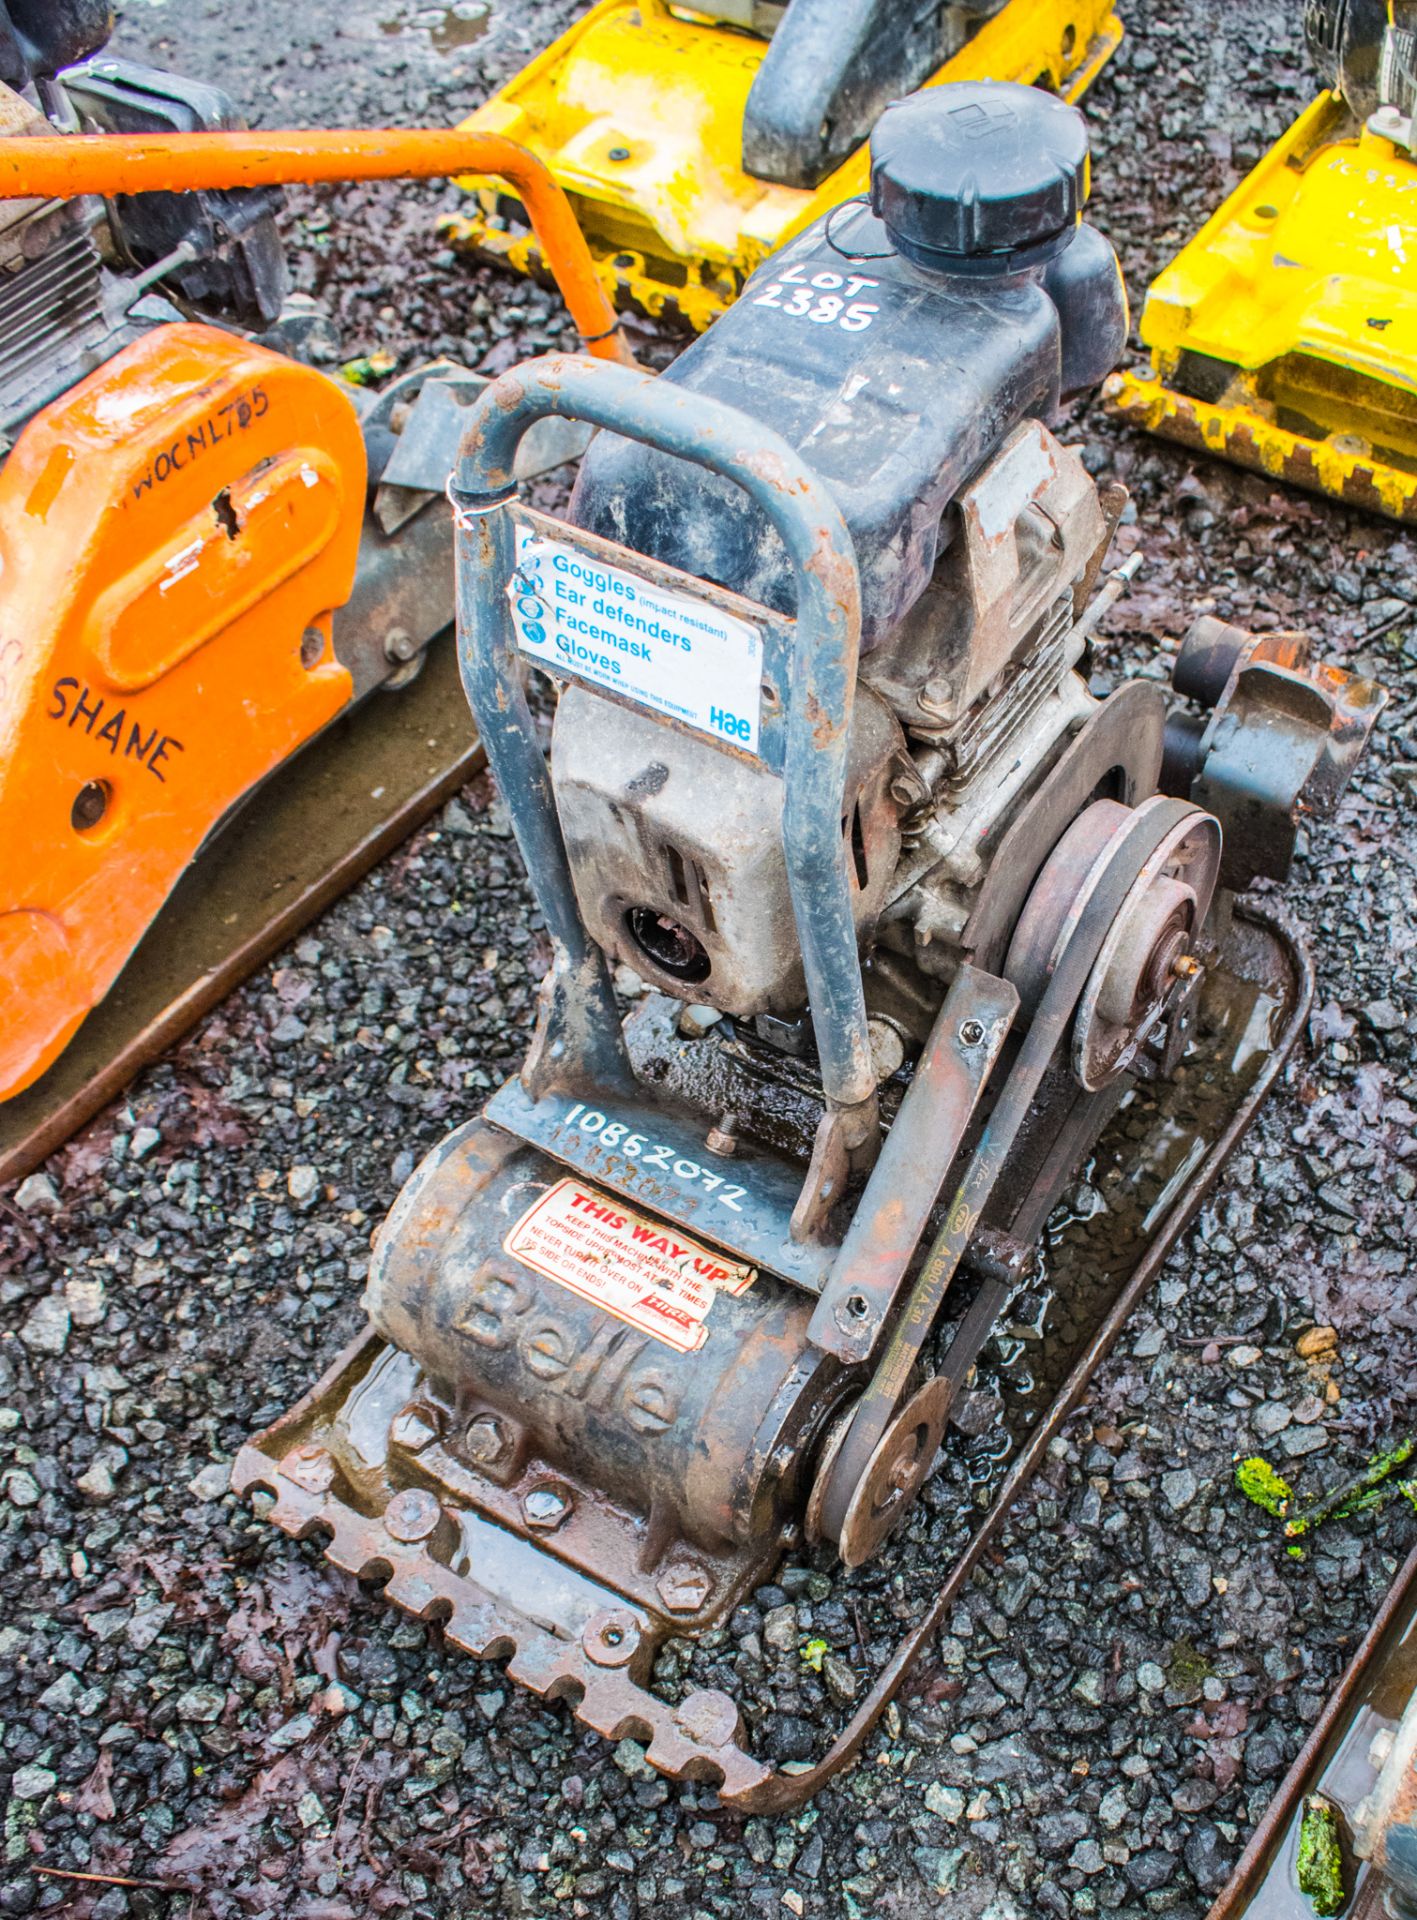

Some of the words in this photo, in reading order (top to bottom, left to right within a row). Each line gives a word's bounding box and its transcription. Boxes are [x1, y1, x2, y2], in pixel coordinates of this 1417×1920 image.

[752, 284, 879, 332] 2385
[779, 264, 879, 297] LOT
[552, 554, 636, 601] Goggles
[639, 595, 677, 620] (impact
[680, 613, 728, 642] resistant)
[555, 579, 587, 607] Ear
[593, 598, 692, 652] defenders
[555, 606, 652, 663] Facemask
[555, 633, 621, 675] Gloves
[48, 676, 185, 783] SHANE
[530, 1226, 562, 1248] NEVER
[600, 1264, 627, 1285] OVER
[627, 1280, 643, 1293] ON
[539, 1246, 561, 1263] SIDE
[561, 1259, 576, 1272] OR
[576, 1267, 606, 1289] ENDS!
[545, 1215, 584, 1241] TOPSIDE
[643, 1270, 658, 1282] AT
[678, 1288, 708, 1309] TIMES
[565, 1214, 591, 1229] KEEP
[592, 1227, 614, 1243] THIS
[683, 1276, 704, 1292] THE
[570, 1192, 628, 1230] THIS
[632, 1225, 689, 1260] WAY
[691, 1258, 730, 1283] UP
[928, 1257, 946, 1285] 800
[647, 1296, 689, 1324] HIRE
[450, 1256, 679, 1439] Belle
